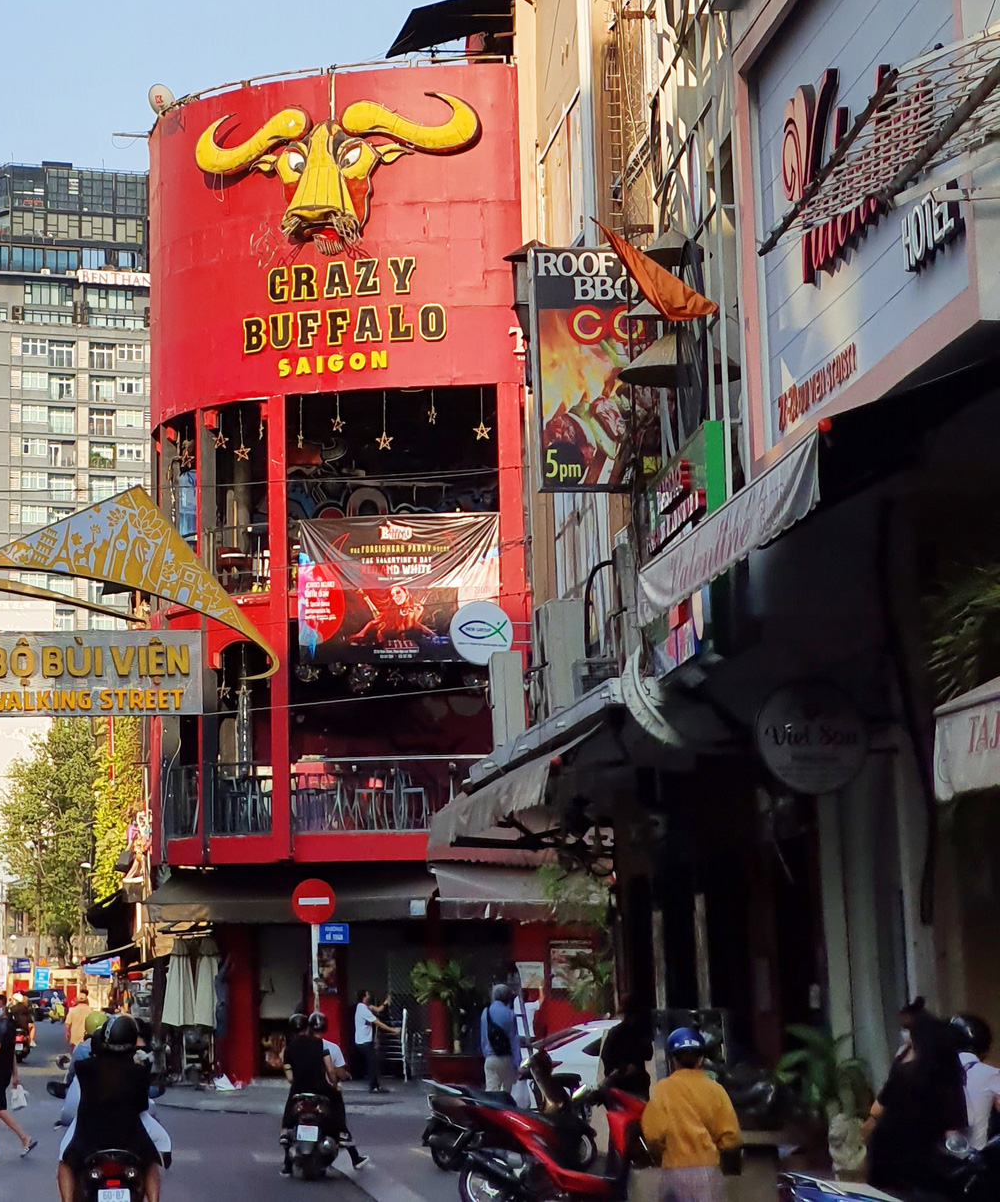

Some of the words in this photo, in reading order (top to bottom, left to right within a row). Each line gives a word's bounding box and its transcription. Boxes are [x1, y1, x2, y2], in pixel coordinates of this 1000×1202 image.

[537, 252, 626, 277] ROOF
[267, 256, 416, 303] CRAZY
[574, 276, 640, 304] BBQ
[243, 303, 447, 354] BUFFALO
[278, 350, 388, 377] SAIGON
[546, 448, 582, 482] 5pm
[361, 545, 405, 554] FOREIGNERS
[407, 544, 432, 553] PARTY
[361, 565, 378, 575] RED
[380, 564, 400, 575] AND
[402, 564, 432, 575] WHITE
[42, 637, 105, 678] BÙI
[109, 637, 191, 685] VIỆN
[100, 688, 185, 710] STREET
